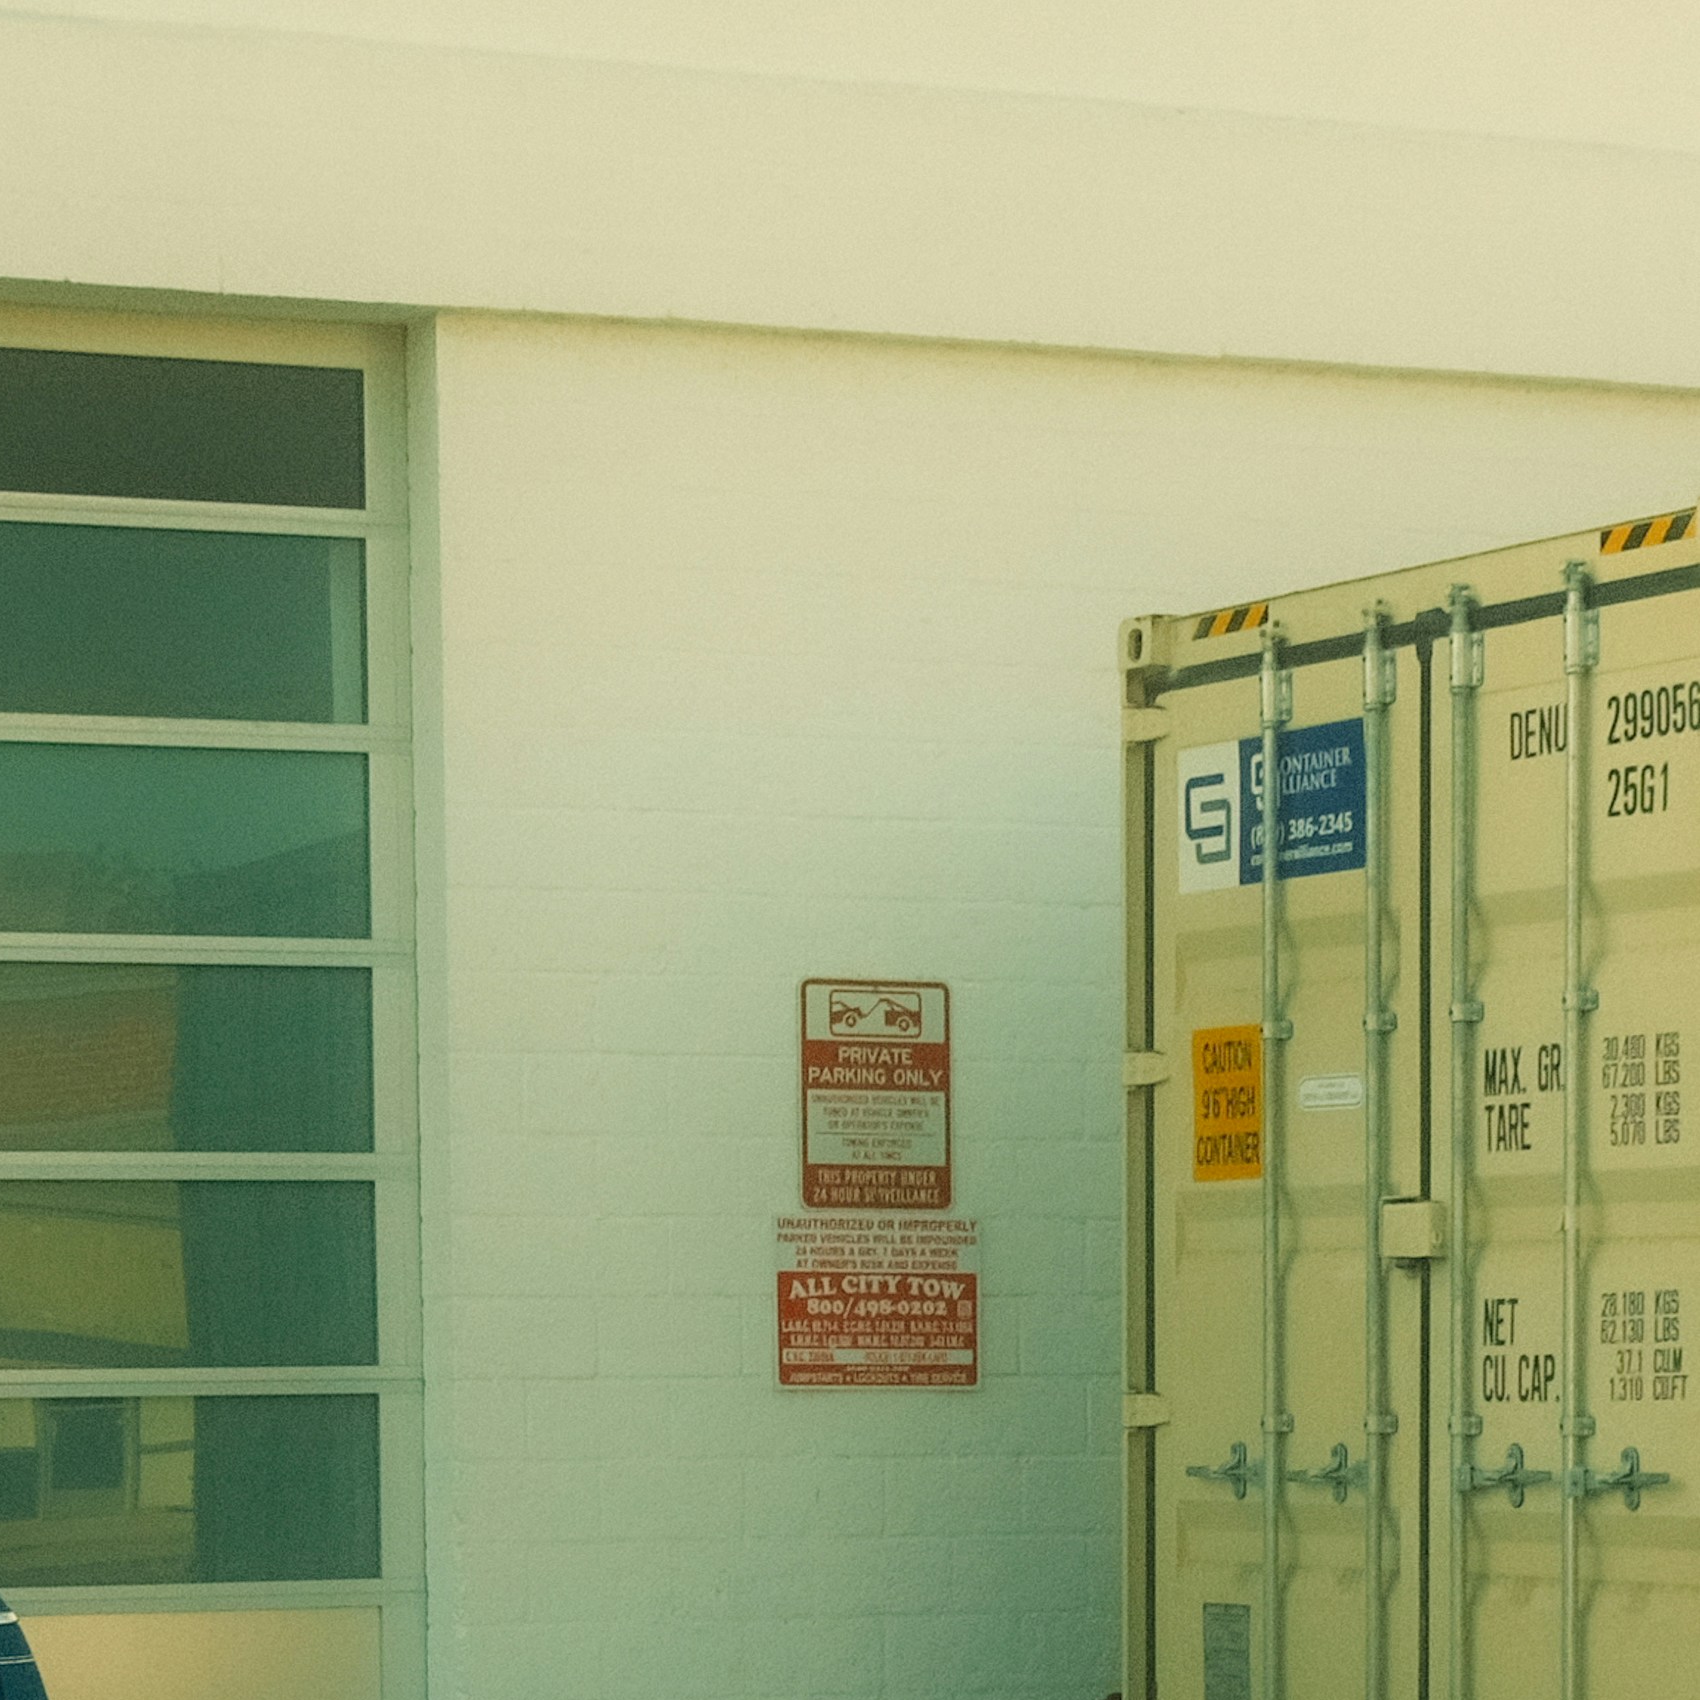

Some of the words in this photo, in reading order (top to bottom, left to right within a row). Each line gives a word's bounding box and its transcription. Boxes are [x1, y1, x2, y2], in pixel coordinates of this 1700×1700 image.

[1511, 703, 1568, 760] DENU
[1608, 681, 1700, 745] 299056
[1608, 762, 1668, 817] 25G1
[1288, 811, 1353, 840] 386-2345
[838, 1046, 913, 1065] PRIVATE
[1202, 1040, 1253, 1075] CAUTION
[1655, 1032, 1681, 1059] KGS
[808, 1066, 886, 1085] PARKING
[893, 1069, 943, 1086] ONLY
[1484, 1046, 1527, 1097] MAX.
[1655, 1059, 1681, 1086] LBS
[1655, 1091, 1681, 1116] KGS
[1485, 1102, 1532, 1153] TARE
[1655, 1118, 1681, 1145] LBS
[1196, 1131, 1261, 1166] CONTAINER
[777, 1218, 874, 1231] UNAUTHORIZED
[877, 1219, 895, 1230] OR
[898, 1219, 977, 1233] IMPROPERLY
[789, 1276, 838, 1300] ALL
[841, 1275, 902, 1294] CITY
[906, 1276, 966, 1300] TOW
[1655, 1289, 1680, 1315] KGS
[1484, 1297, 1519, 1346] NET
[1655, 1317, 1680, 1343] LBS
[1483, 1354, 1510, 1402] CU.
[1518, 1353, 1560, 1403] CAP.
